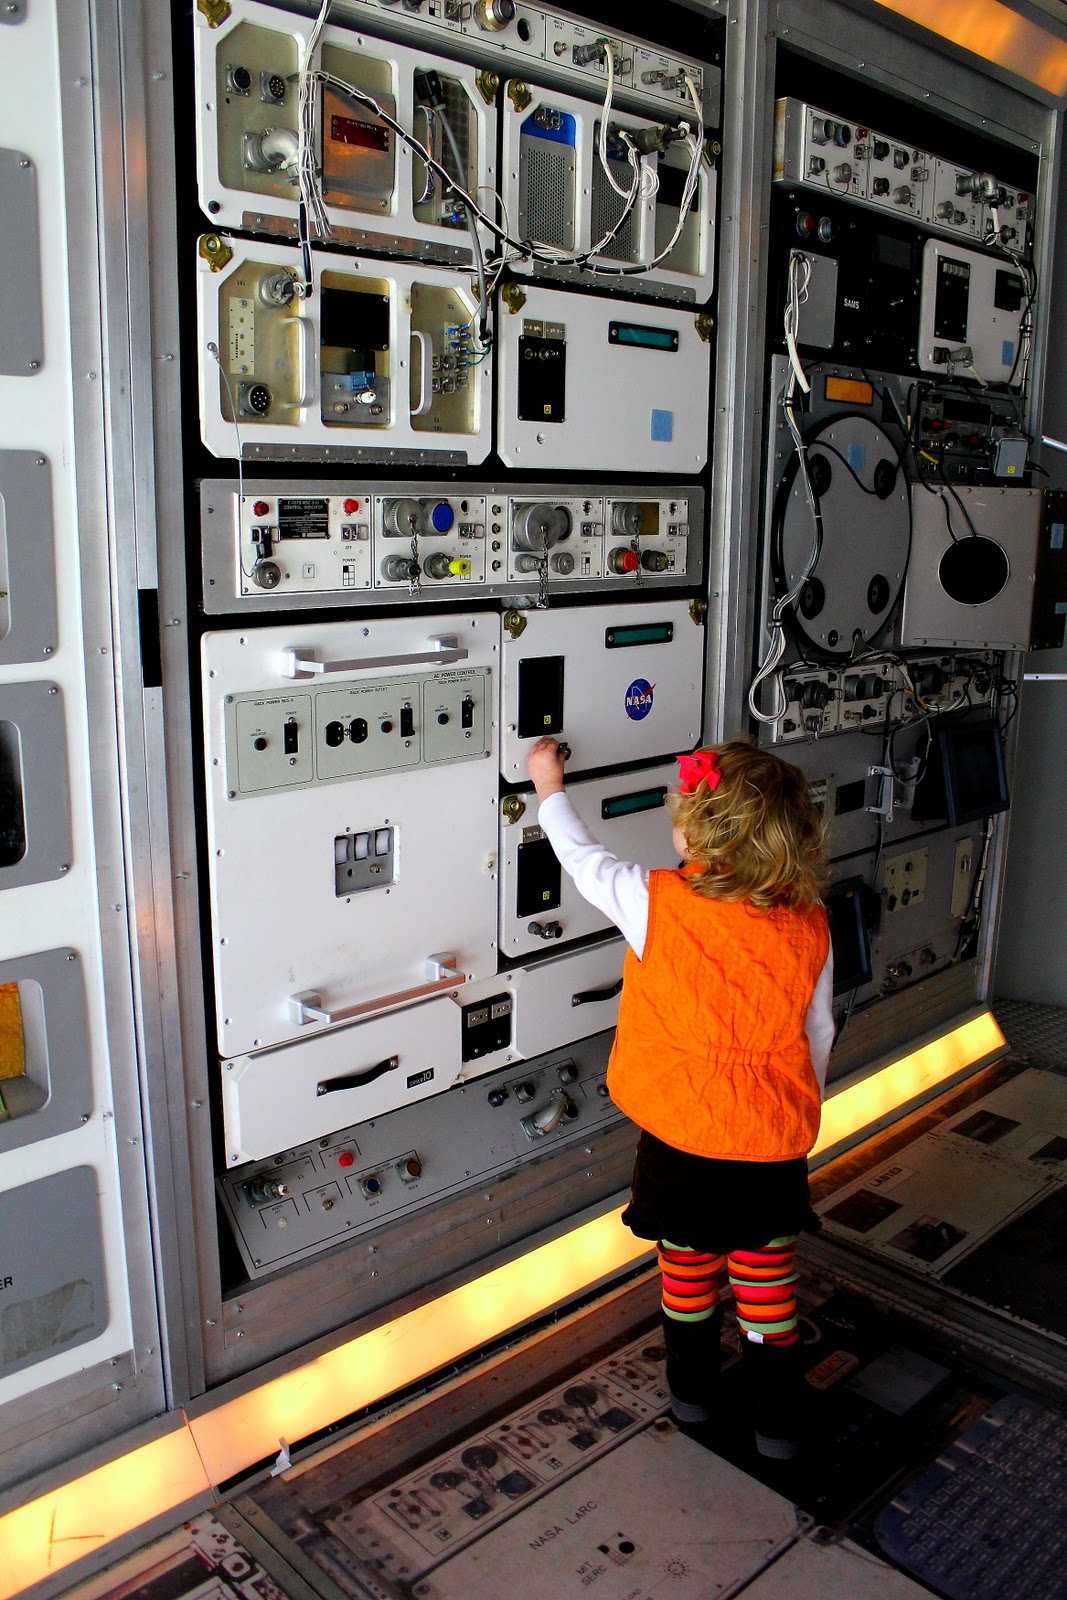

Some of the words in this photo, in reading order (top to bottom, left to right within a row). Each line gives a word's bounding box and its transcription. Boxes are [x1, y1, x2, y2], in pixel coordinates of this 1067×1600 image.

[843, 298, 860, 310] SAMS
[456, 669, 476, 677] CONTROL
[626, 694, 652, 707] NASA
[528, 1525, 564, 1551] NASA
[565, 1500, 598, 1525] LARC
[575, 1560, 593, 1576] MIT
[580, 1564, 608, 1587] SERC
